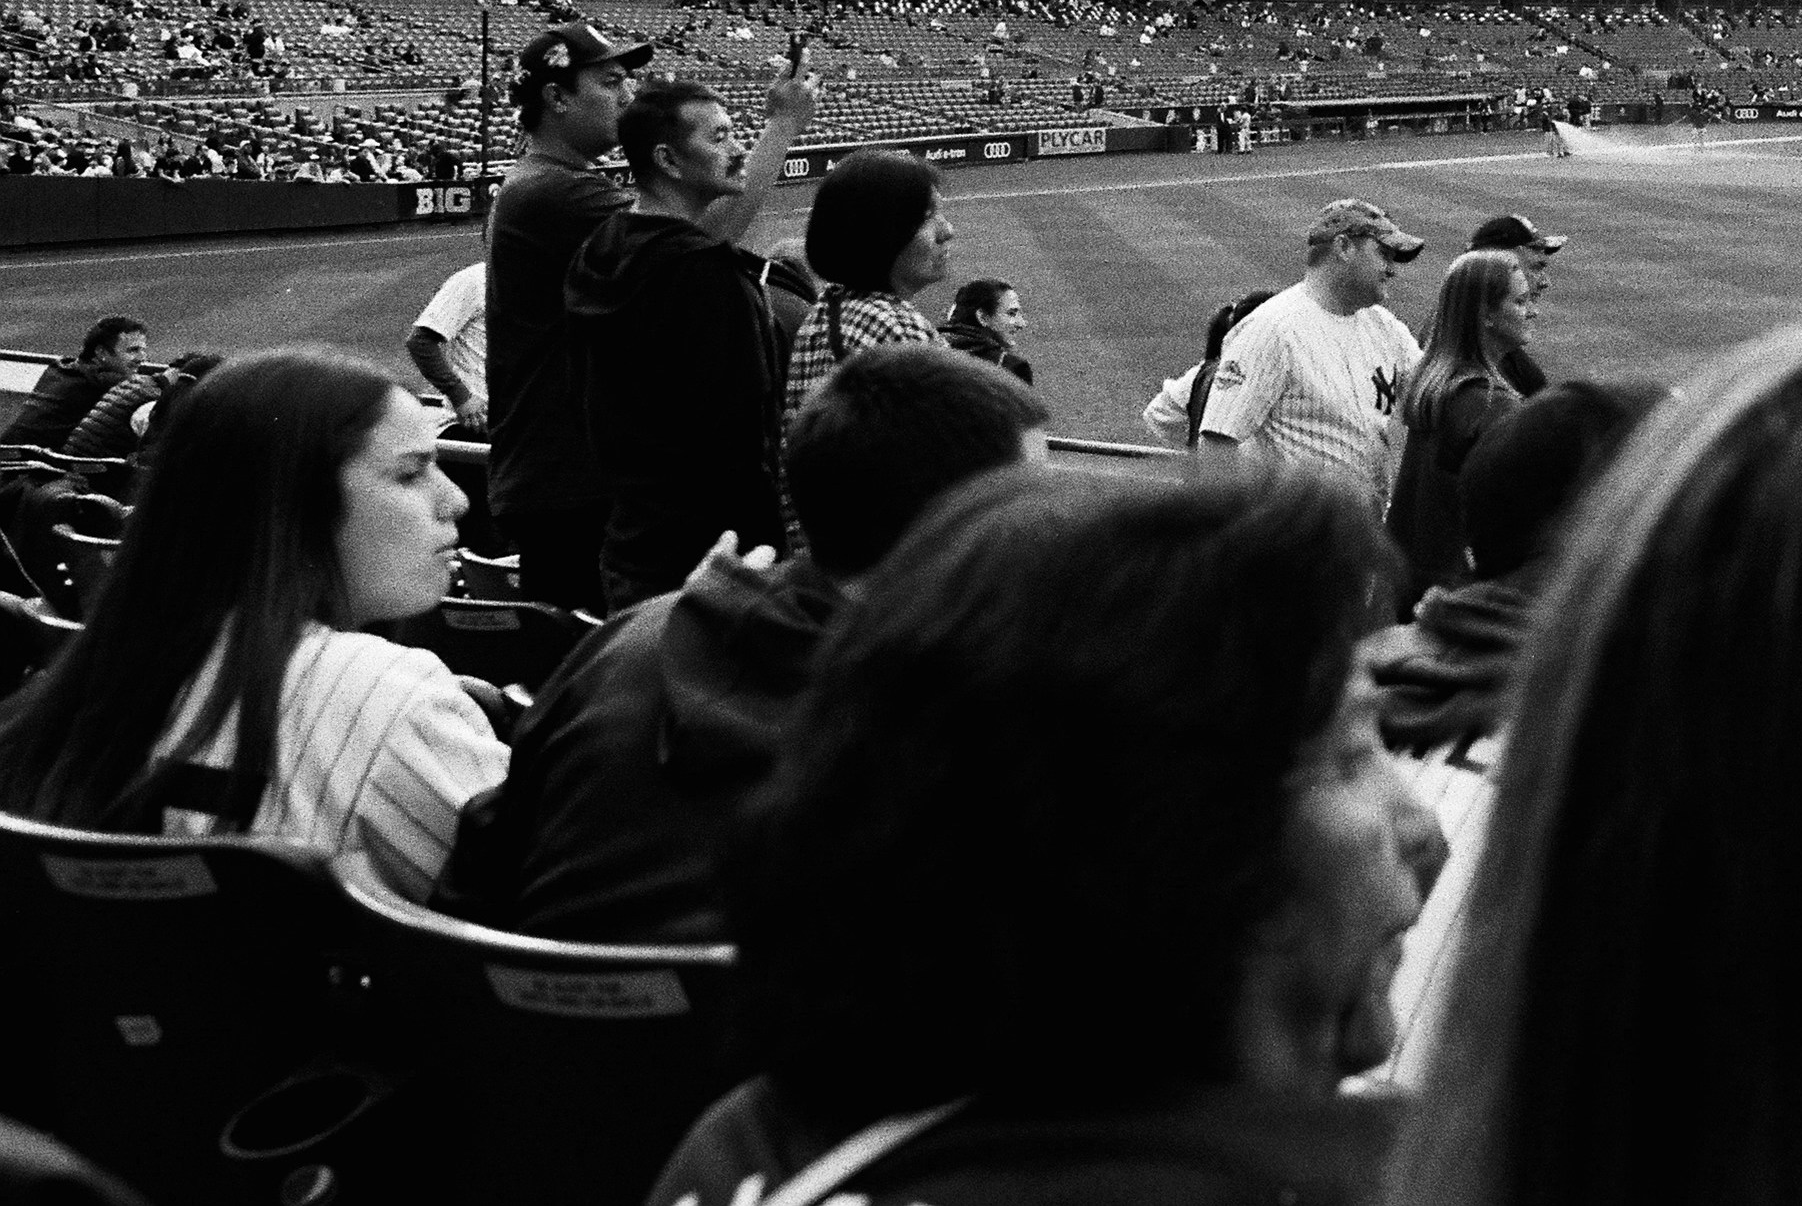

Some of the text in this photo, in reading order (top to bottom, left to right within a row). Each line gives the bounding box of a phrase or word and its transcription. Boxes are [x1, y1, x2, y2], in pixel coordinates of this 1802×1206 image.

[1776, 109, 1797, 119] Audi
[1040, 130, 1106, 149] PLYCAR
[415, 186, 472, 215] BIG
